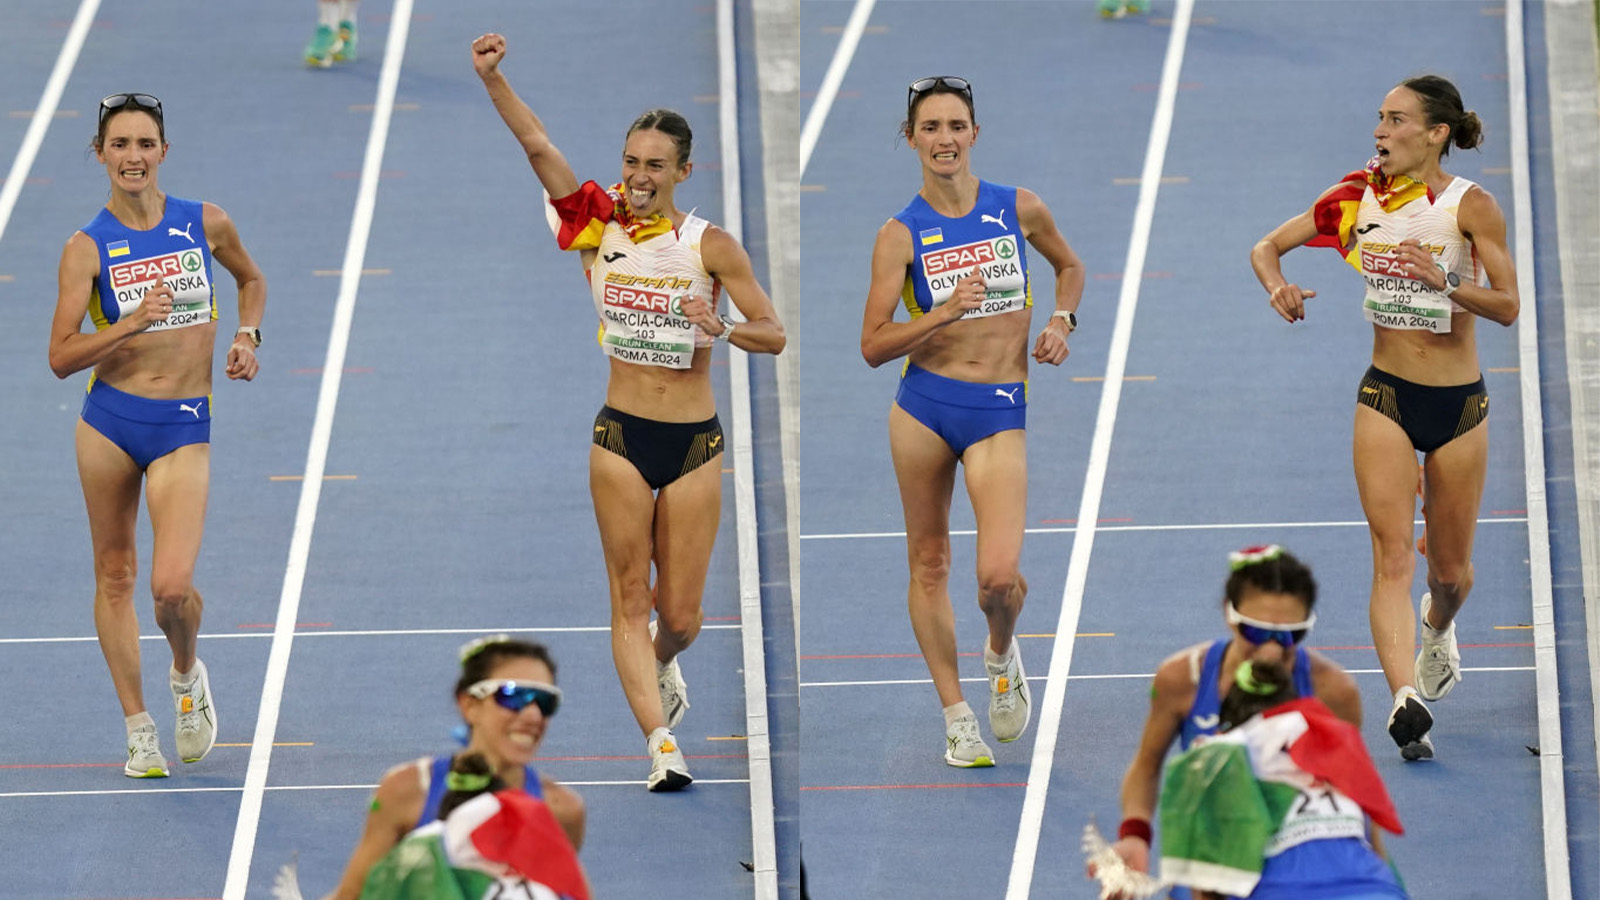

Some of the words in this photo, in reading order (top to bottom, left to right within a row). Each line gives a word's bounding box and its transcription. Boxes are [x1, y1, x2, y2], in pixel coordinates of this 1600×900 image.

[926, 245, 993, 272] SPAR
[114, 258, 179, 284] SPAR
[606, 287, 668, 311] SPAR
[985, 300, 1012, 312] 2024
[1392, 294, 1412, 304] 103
[1380, 304, 1399, 312] RUN
[1400, 305, 1427, 316] CLEAN
[171, 313, 198, 325] 2024
[605, 309, 691, 330] GARCIA-CARO
[1373, 312, 1407, 326] ROMA
[1410, 316, 1437, 329] 2024
[635, 329, 655, 339] 103
[622, 339, 641, 347] RUN
[642, 340, 672, 350] CLEAN
[614, 347, 649, 361] ROMA
[652, 353, 680, 365] 2024
